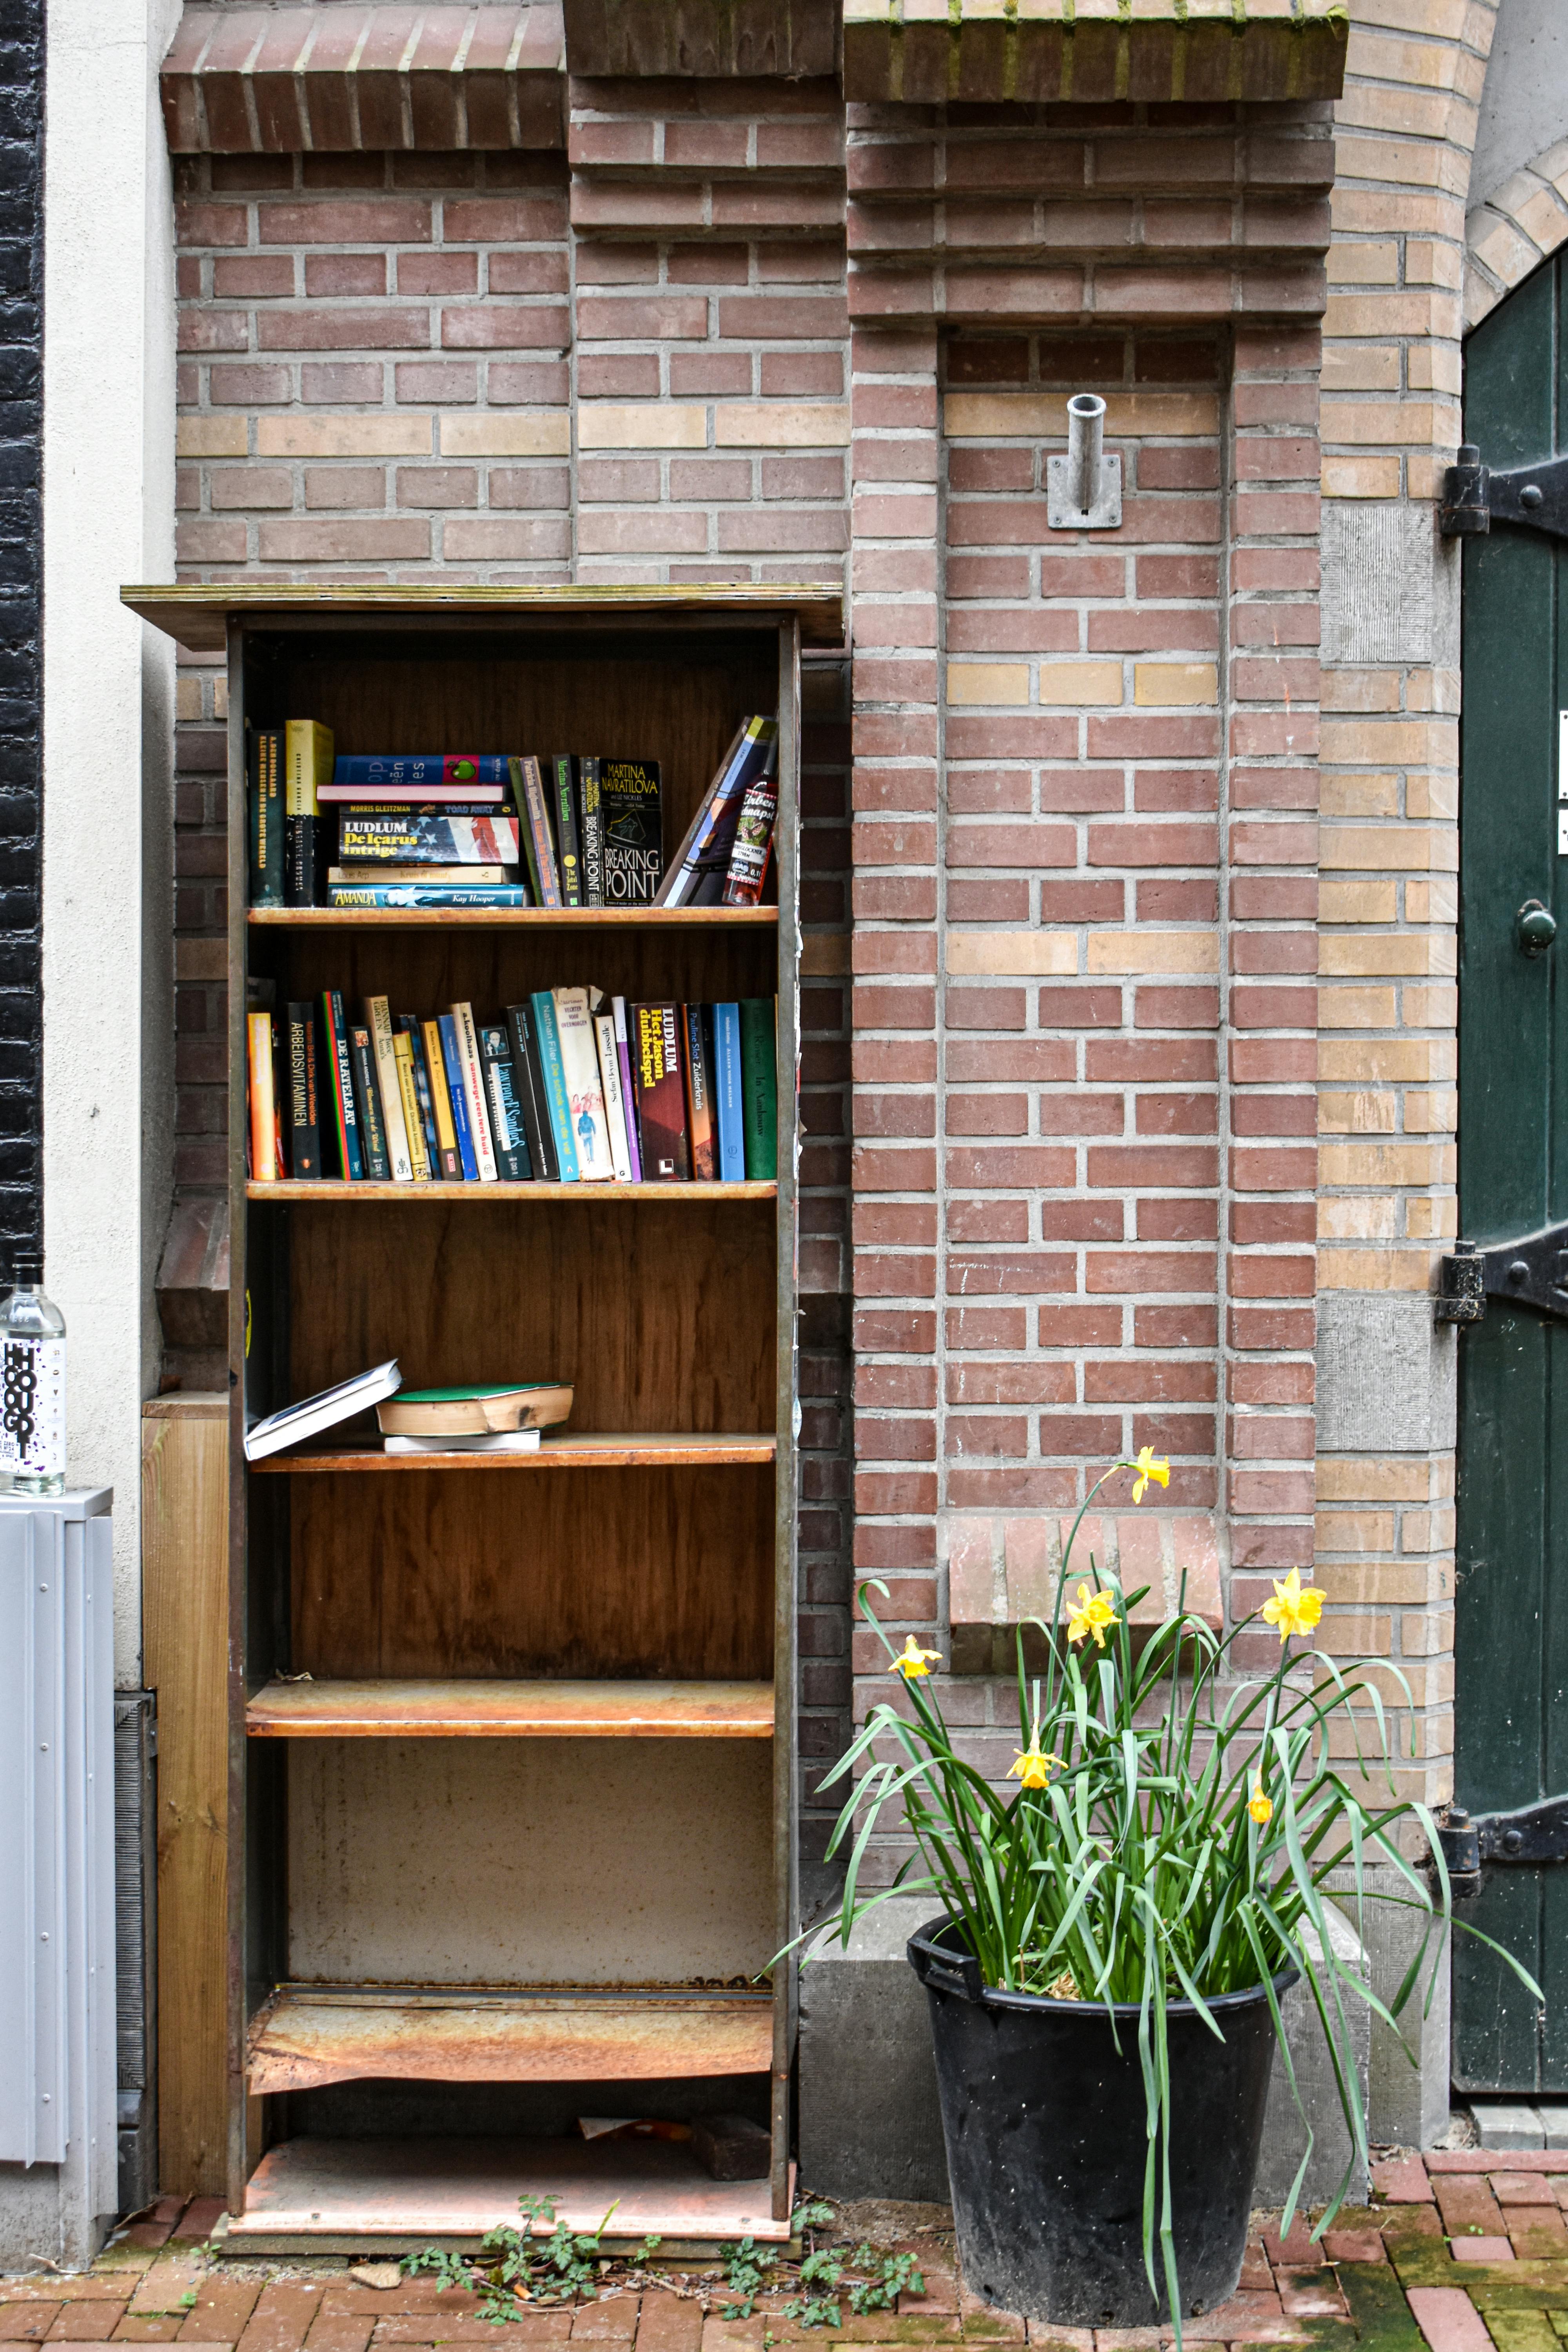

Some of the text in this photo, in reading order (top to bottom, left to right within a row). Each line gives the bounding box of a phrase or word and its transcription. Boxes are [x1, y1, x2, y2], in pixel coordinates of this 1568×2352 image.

[524, 760, 534, 786] Patricia
[558, 760, 569, 786] Martina
[602, 777, 658, 794] NAVRATILOVA
[608, 763, 646, 779] MARTINA
[528, 787, 541, 819] Highsmith
[560, 787, 571, 821] Navratilova
[344, 833, 417, 845] De Icarus
[345, 822, 408, 833] LUDLUM
[586, 817, 597, 860] BREAKING
[344, 844, 397, 858] intrige
[605, 848, 659, 870] BREAKING
[339, 871, 355, 879] Louis
[588, 862, 599, 891] POINT
[606, 869, 659, 898] POINT
[335, 889, 377, 905] AMANDA
[452, 894, 467, 903] Kay
[373, 1001, 383, 1030] GREEN
[380, 1000, 390, 1034] HANNAH
[378, 1038, 387, 1060] Anna's
[463, 1012, 474, 1058] a.koolhaas
[602, 1025, 613, 1056] Lassalle
[640, 1009, 656, 1088] dubbelspel
[651, 1009, 664, 1080] Het Jason
[662, 1009, 677, 1073] LUDLUM
[290, 1022, 307, 1126] ARBEIDSVITAMINEN
[337, 1039, 355, 1125] DE RATELRAT
[468, 1062, 481, 1100] vanwege
[542, 1005, 572, 1155] Nathan Filer De schok van de val
[693, 1062, 703, 1109] Zuiderkruis
[756, 1076, 766, 1086] In
[367, 1087, 375, 1115] Bloemen
[610, 1080, 618, 1102] Stefan
[370, 1123, 378, 1132] de
[755, 1091, 767, 1136] Aanbouw
[371, 1132, 380, 1152] Wind
[480, 1136, 489, 1155] huid
